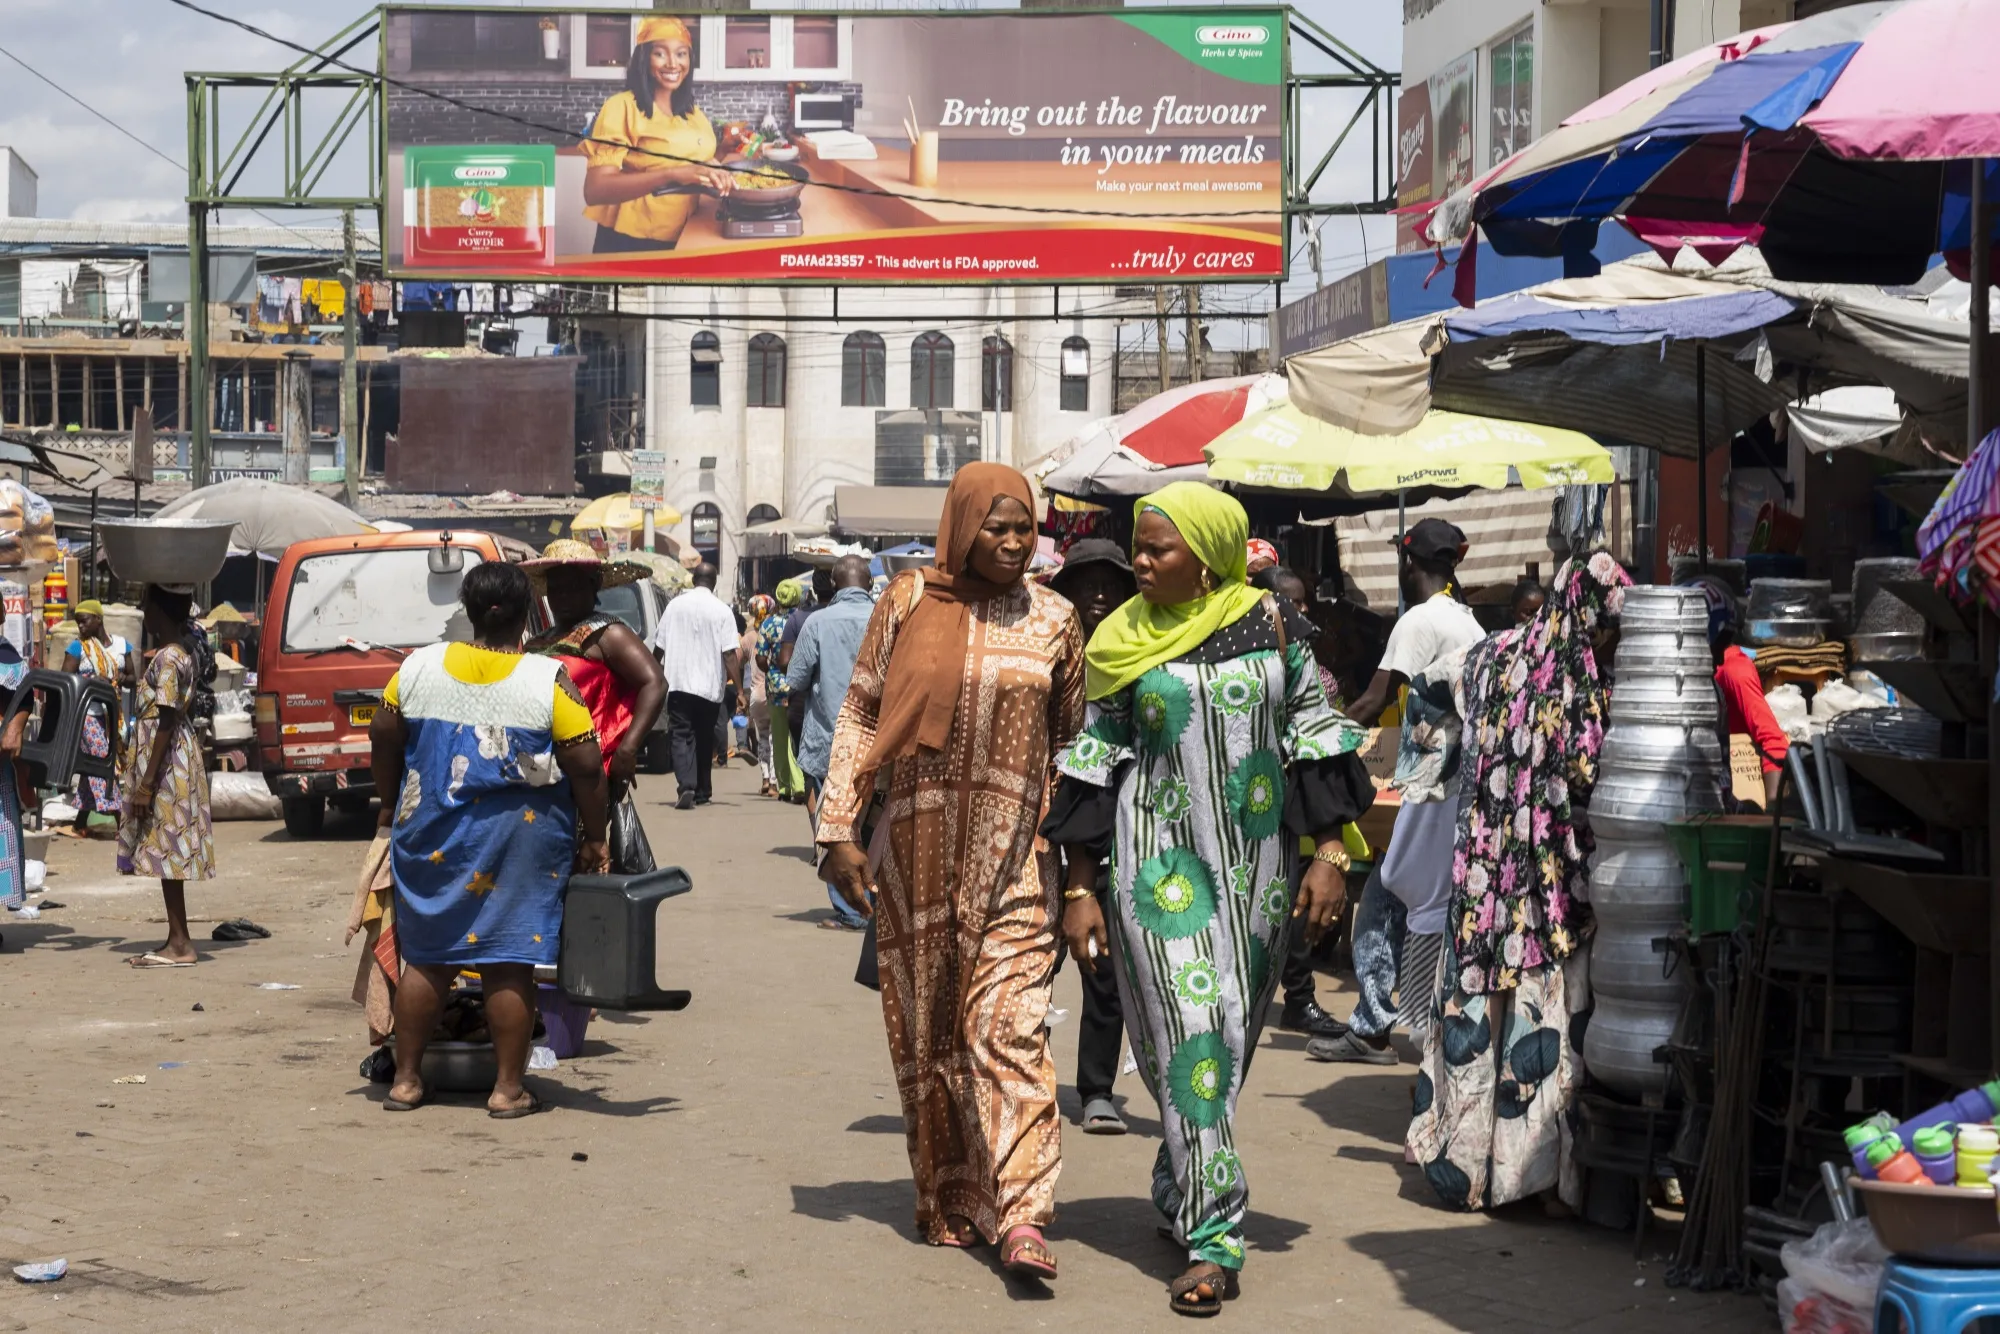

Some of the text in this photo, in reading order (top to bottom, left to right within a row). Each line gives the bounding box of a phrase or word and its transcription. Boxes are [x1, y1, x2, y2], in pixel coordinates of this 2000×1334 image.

[1212, 28, 1252, 40] Gino
[1201, 48, 1226, 58] Herbs
[1237, 48, 1264, 60] Spices
[940, 95, 1267, 135] Bring out the flavour
[1060, 136, 1266, 174] in your meals
[465, 167, 496, 177] Gino
[1096, 180, 1263, 194] Make your next meal awesome
[468, 227, 494, 238] Curry
[458, 238, 504, 247] POWDER
[875, 255, 900, 268] This
[902, 256, 940, 269] advert
[942, 257, 953, 269] is
[955, 257, 980, 269] FDA
[982, 256, 1040, 272] approved.
[1193, 249, 1255, 268] cares
[1286, 299, 1306, 340] JESUS
[1307, 296, 1314, 333] IS
[1315, 289, 1328, 328] THE
[1330, 274, 1363, 322] ANSWER
[1244, 469, 1276, 482] WIN
[1396, 468, 1458, 484] betPawa
[286, 699, 326, 707] CARAVAN
[357, 708, 373, 721] GR
